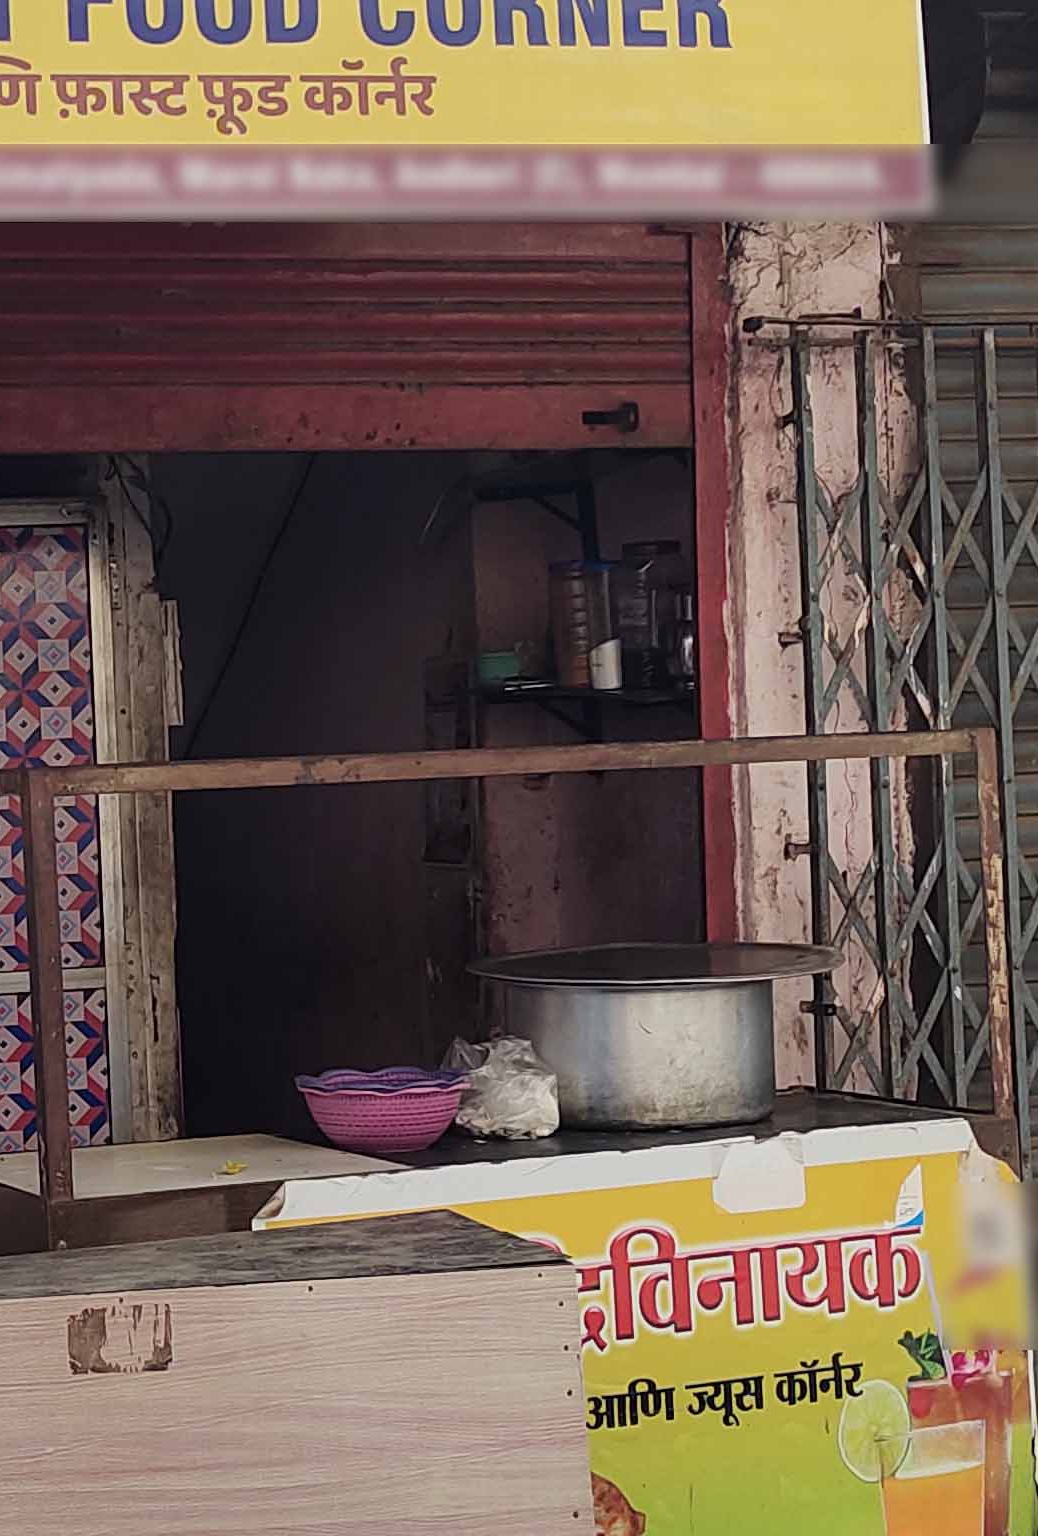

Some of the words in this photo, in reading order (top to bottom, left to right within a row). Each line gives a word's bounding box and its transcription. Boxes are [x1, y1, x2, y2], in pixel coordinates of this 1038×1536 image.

[299, 56, 437, 116] कॉर्नर
[585, 1378, 675, 1431] आणि
[684, 1375, 764, 1428] ज्यूस
[773, 1351, 864, 1407] कॉर्नर
